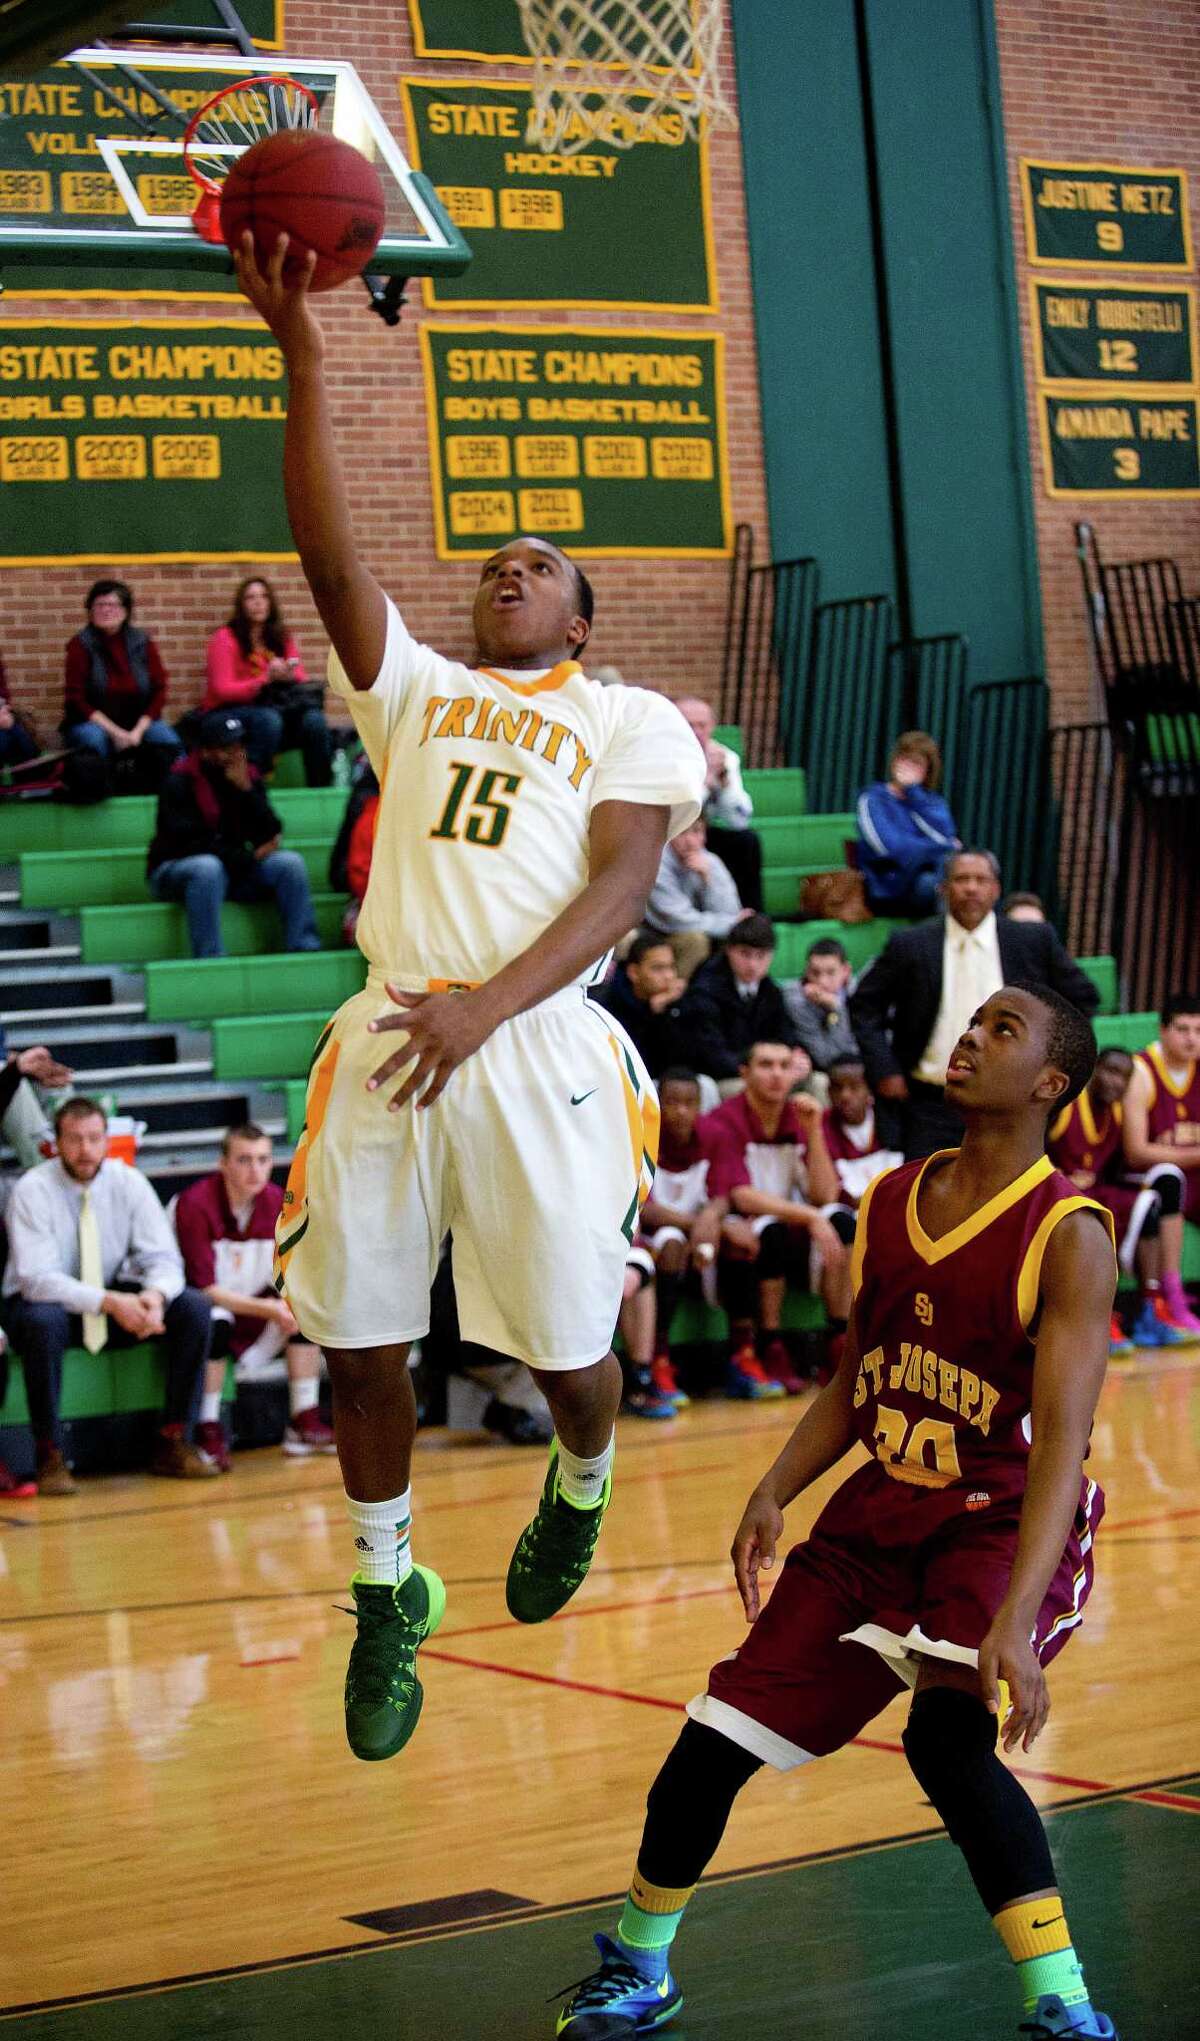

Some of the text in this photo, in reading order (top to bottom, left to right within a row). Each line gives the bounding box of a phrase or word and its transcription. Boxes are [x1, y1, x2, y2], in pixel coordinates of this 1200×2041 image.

[0, 83, 83, 117] TATE
[427, 103, 520, 138] STATE
[504, 152, 620, 178] HOCKEY
[0, 175, 43, 195] 983
[1038, 178, 1118, 212] JUSTINE
[1096, 221, 1125, 252] 9
[0, 346, 285, 380] STATE CHAMPIONS
[447, 349, 703, 387] STATE CHAMPIONS
[1098, 339, 1139, 372] 12
[93, 394, 288, 420] BASKETBALL
[444, 397, 711, 425] BOYS BASKETBALL
[1138, 408, 1191, 441] PAPE
[1113, 448, 1142, 480] 3
[418, 696, 594, 792] TRINITY
[428, 759, 526, 849] 15
[889, 1342, 1001, 1437] JOSEPH
